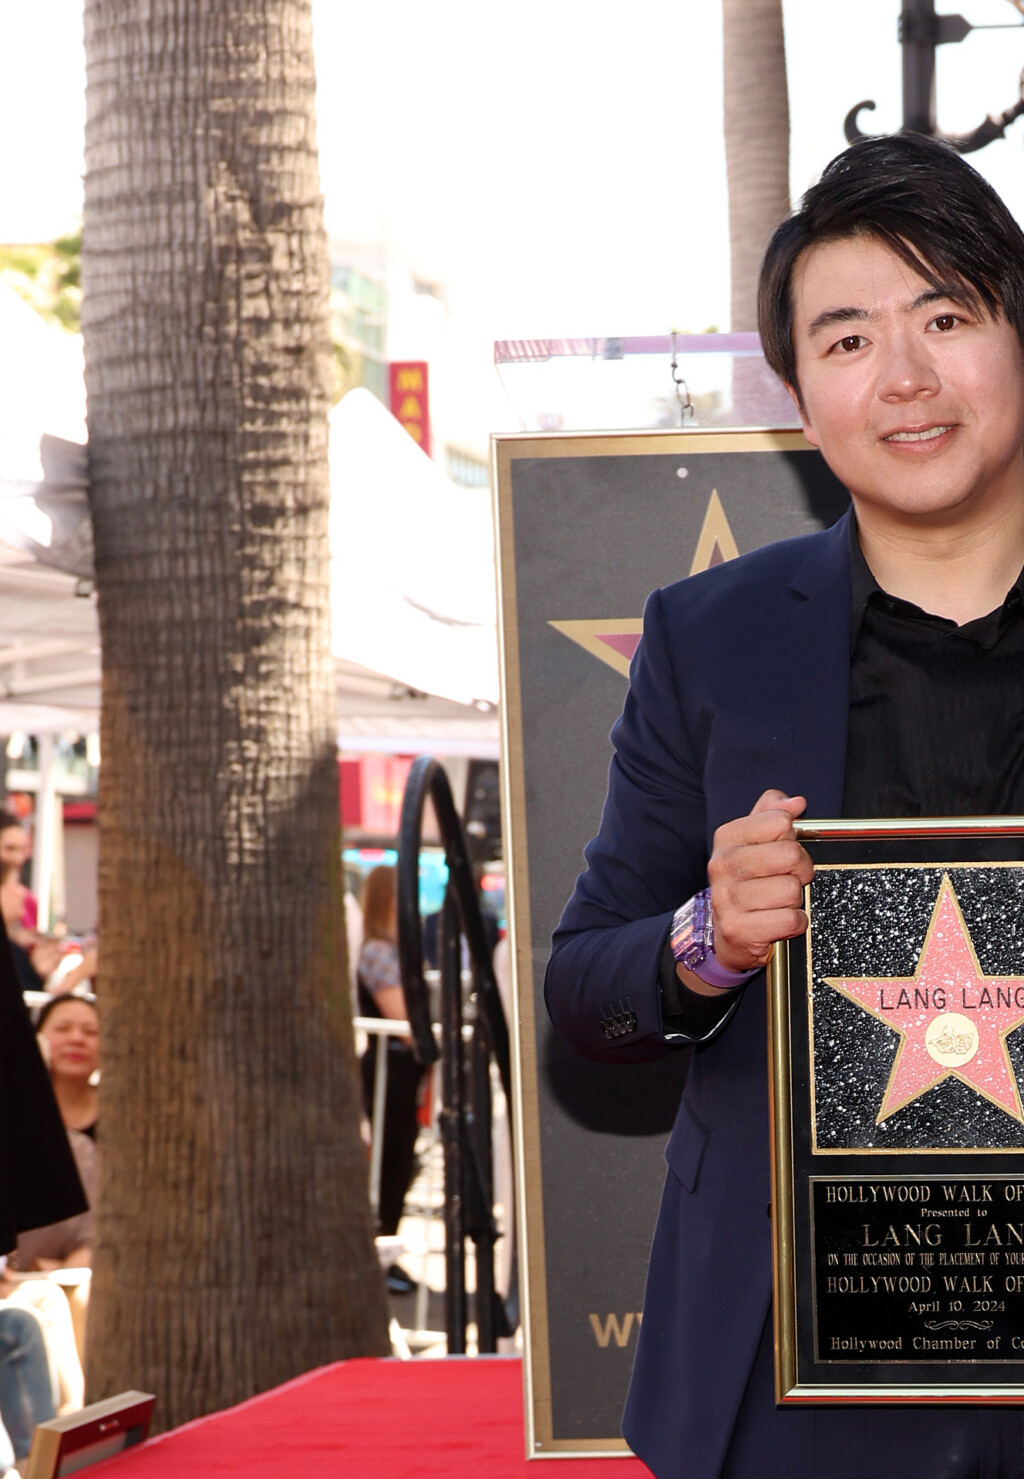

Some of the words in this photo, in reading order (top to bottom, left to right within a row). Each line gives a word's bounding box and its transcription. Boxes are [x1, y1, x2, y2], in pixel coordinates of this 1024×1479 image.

[879, 988, 946, 1010] LANG
[825, 1185, 931, 1203] HOLLYWOOD
[942, 1184, 993, 1202] WALK
[920, 1207, 970, 1218] Presented
[976, 1208, 988, 1217] to
[862, 1223, 943, 1247] LANG
[827, 1253, 839, 1266] ON
[843, 1253, 859, 1266] THE
[862, 1253, 901, 1266] OCCASION
[905, 1252, 915, 1266] OF
[919, 1252, 935, 1266] THE
[939, 1252, 986, 1266] PLACEMENT
[989, 1252, 1000, 1265] OF
[826, 1276, 932, 1293] HOLLYWOOD
[943, 1275, 994, 1293] WALK
[907, 1301, 940, 1315] April
[972, 1301, 1006, 1312] 2024
[589, 1312, 644, 1347] W
[830, 1337, 903, 1353] Hollywood
[912, 1337, 977, 1350] Chamber
[986, 1336, 1002, 1350] of
